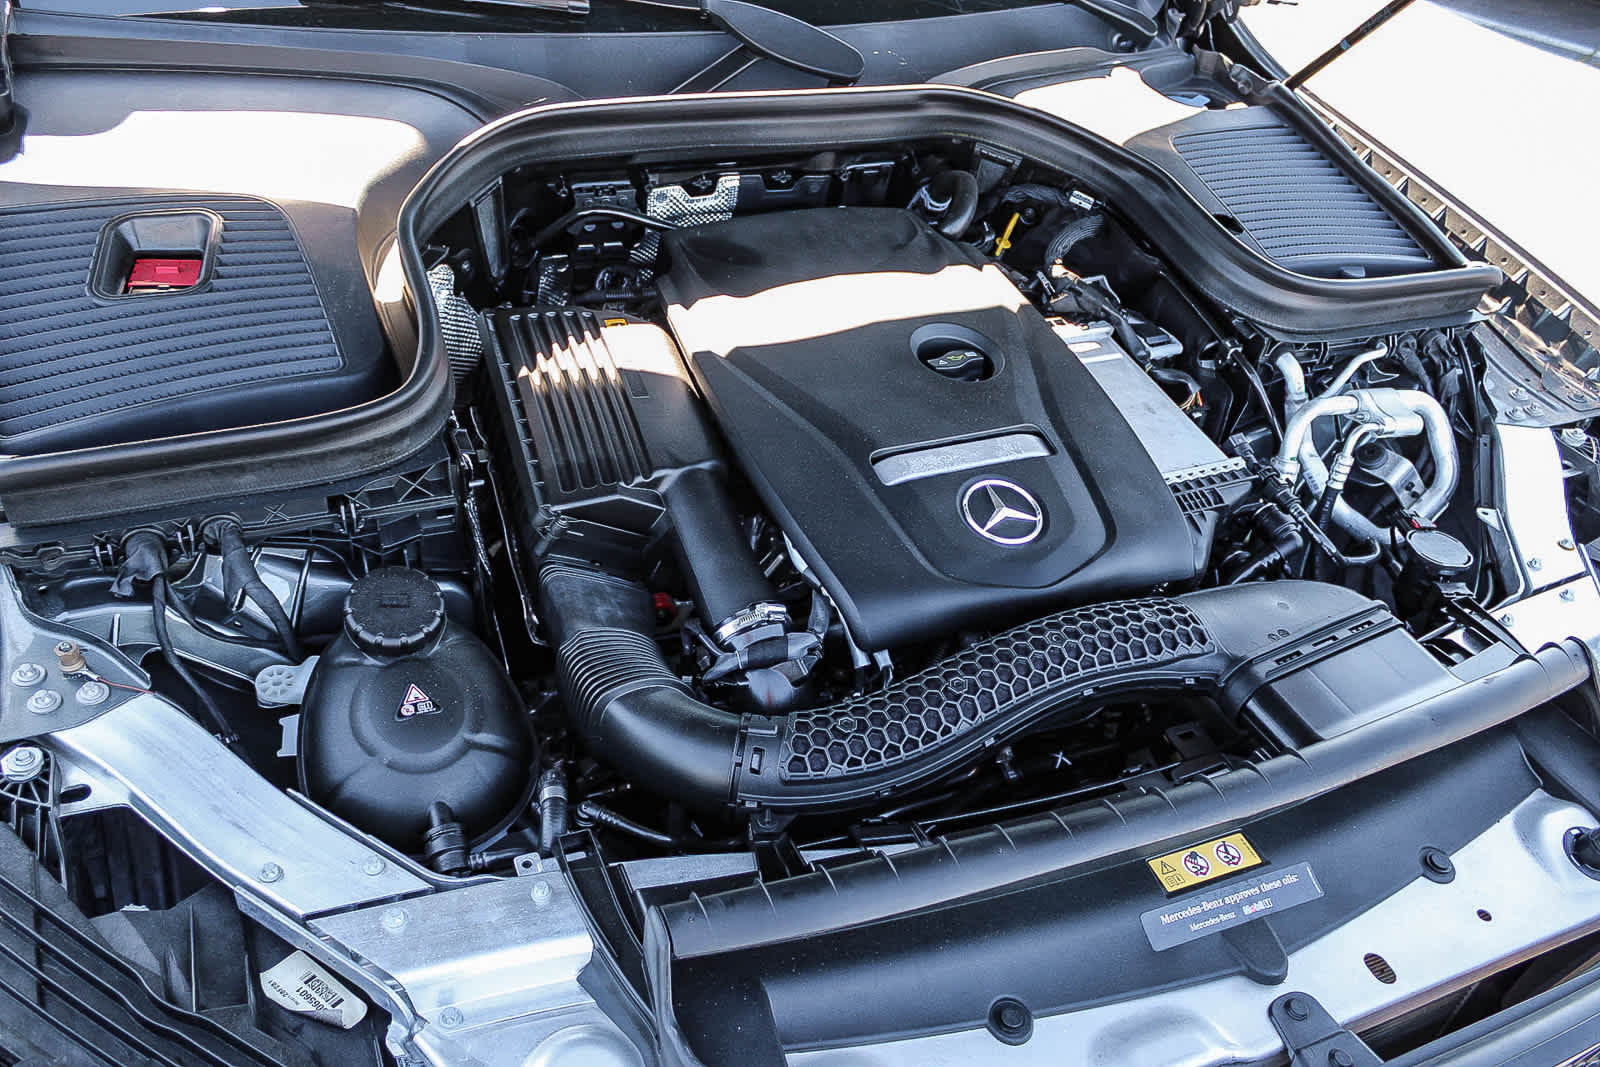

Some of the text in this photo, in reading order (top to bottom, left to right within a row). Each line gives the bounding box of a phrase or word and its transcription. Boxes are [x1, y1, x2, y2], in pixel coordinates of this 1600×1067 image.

[1160, 899, 1224, 925] Mercedes-Benz
[1224, 886, 1260, 905] approves
[1260, 879, 1282, 893] these
[296, 986, 328, 1011] 065601
